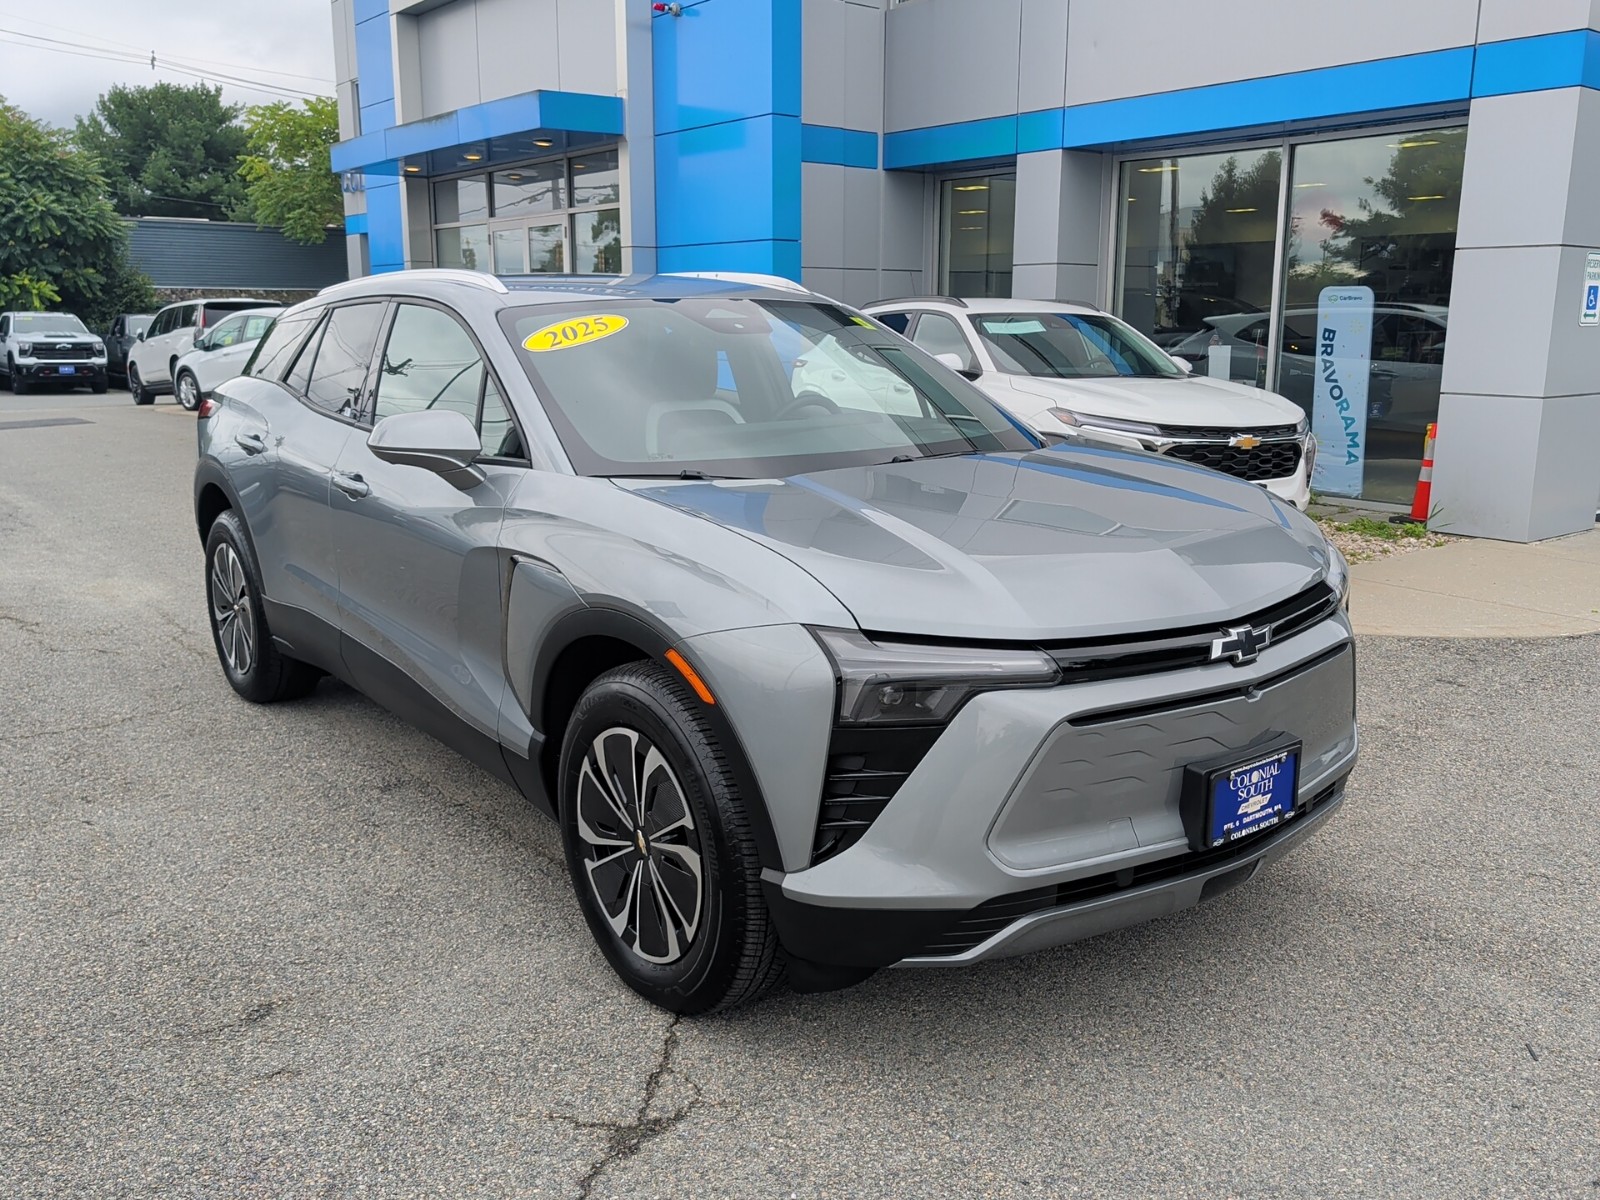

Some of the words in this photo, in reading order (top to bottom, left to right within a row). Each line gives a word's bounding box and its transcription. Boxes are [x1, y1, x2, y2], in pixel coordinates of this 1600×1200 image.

[543, 317, 609, 348] 2025
[1320, 327, 1361, 466] BRAVORAMA
[1229, 762, 1281, 790] COLONIAL
[1237, 777, 1273, 801] SOUTH
[1241, 797, 1268, 810] CHEVROLET
[1230, 823, 1260, 841] COLONIAL
[1259, 816, 1279, 830] SOUTH
